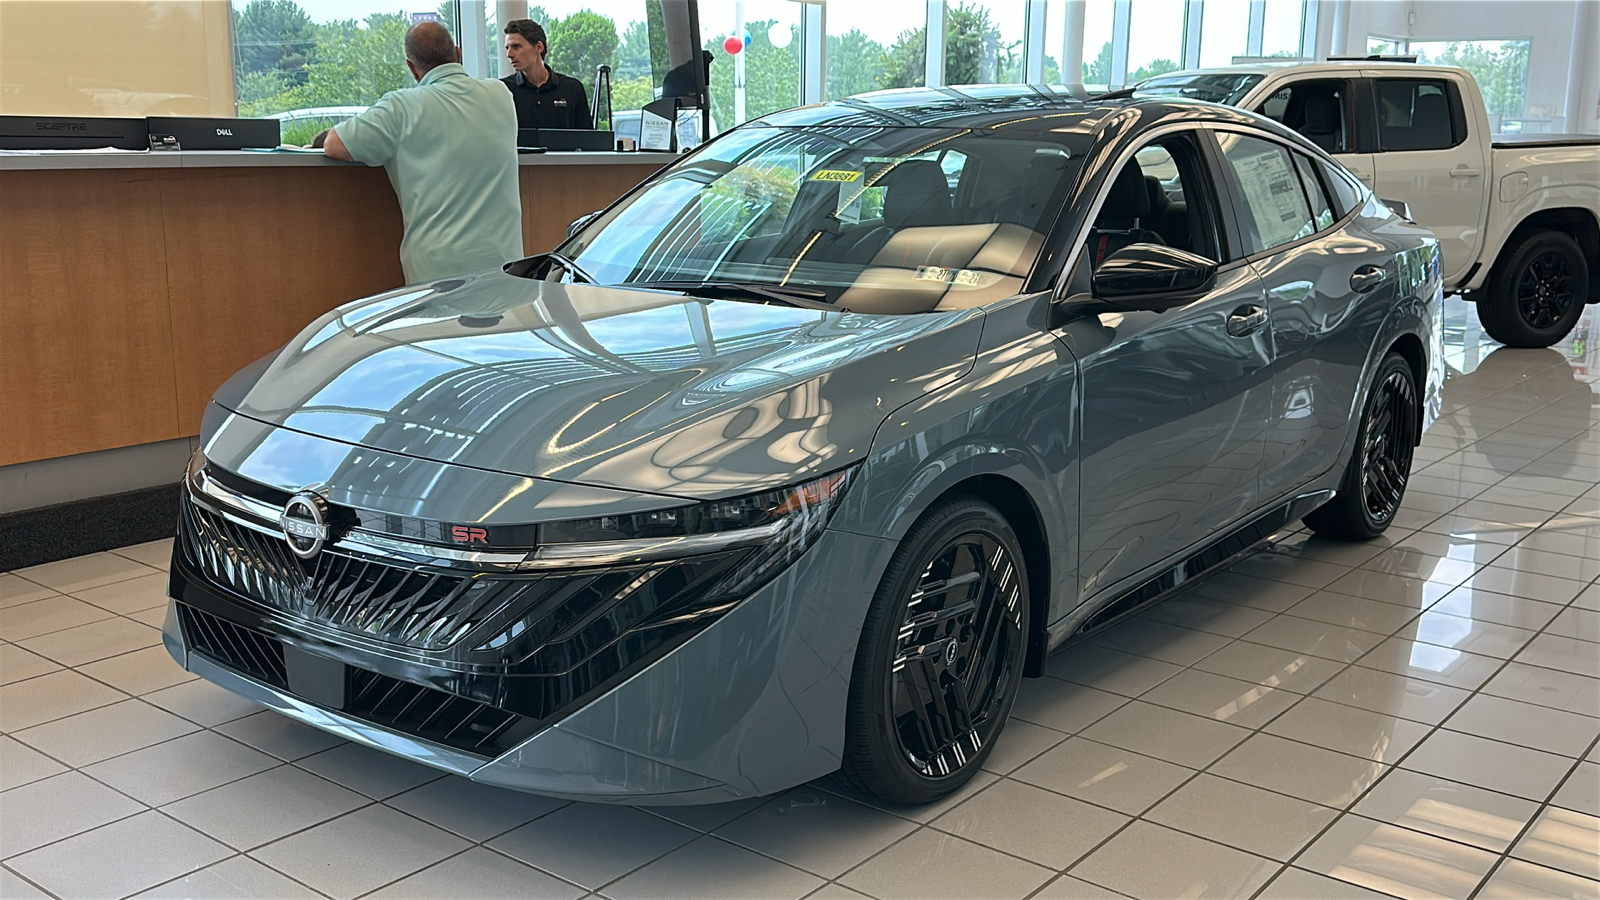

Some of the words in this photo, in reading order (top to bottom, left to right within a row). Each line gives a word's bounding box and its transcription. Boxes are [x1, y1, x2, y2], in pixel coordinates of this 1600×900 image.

[216, 128, 233, 136] DELL
[280, 515, 326, 539] NISSAN
[452, 525, 488, 544] SR
